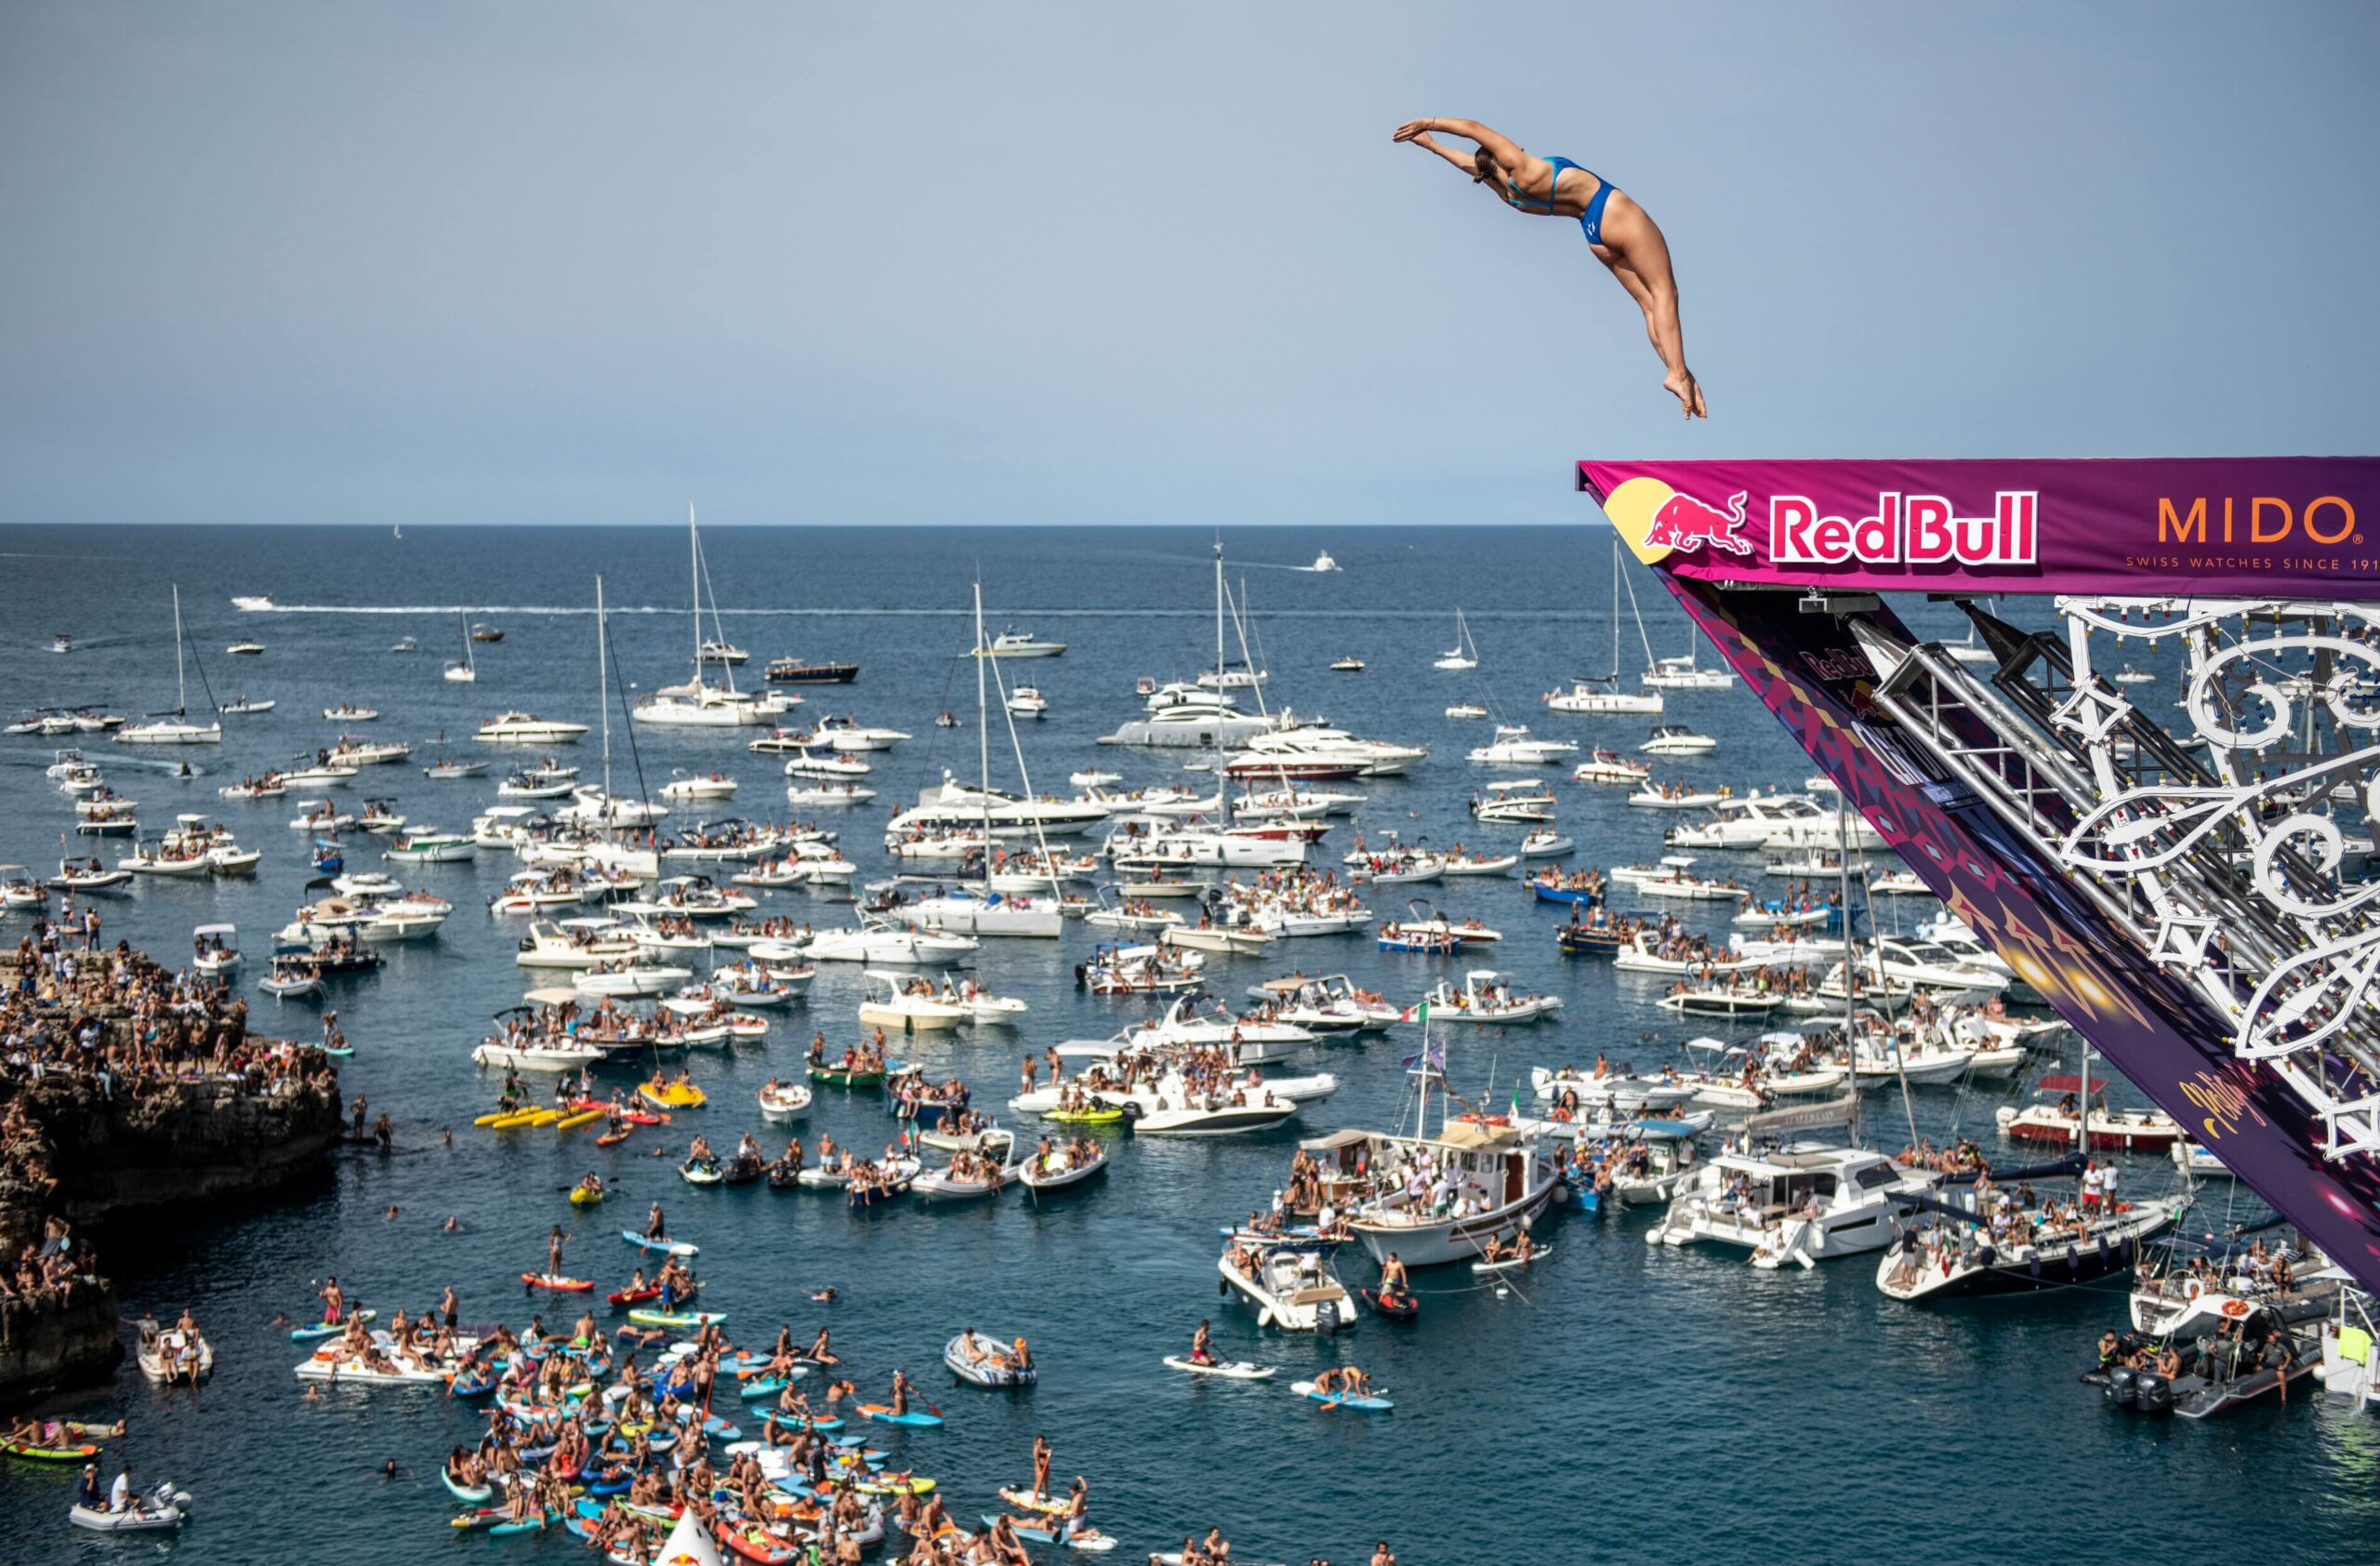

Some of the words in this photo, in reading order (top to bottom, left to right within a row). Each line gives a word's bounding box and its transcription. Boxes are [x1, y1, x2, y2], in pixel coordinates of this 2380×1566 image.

[1770, 492, 1900, 563] Red
[1906, 491, 2038, 564] Bull
[2126, 557, 2179, 566] SWISS
[2190, 558, 2272, 568] WATCHES
[2283, 559, 2340, 569] SINCE
